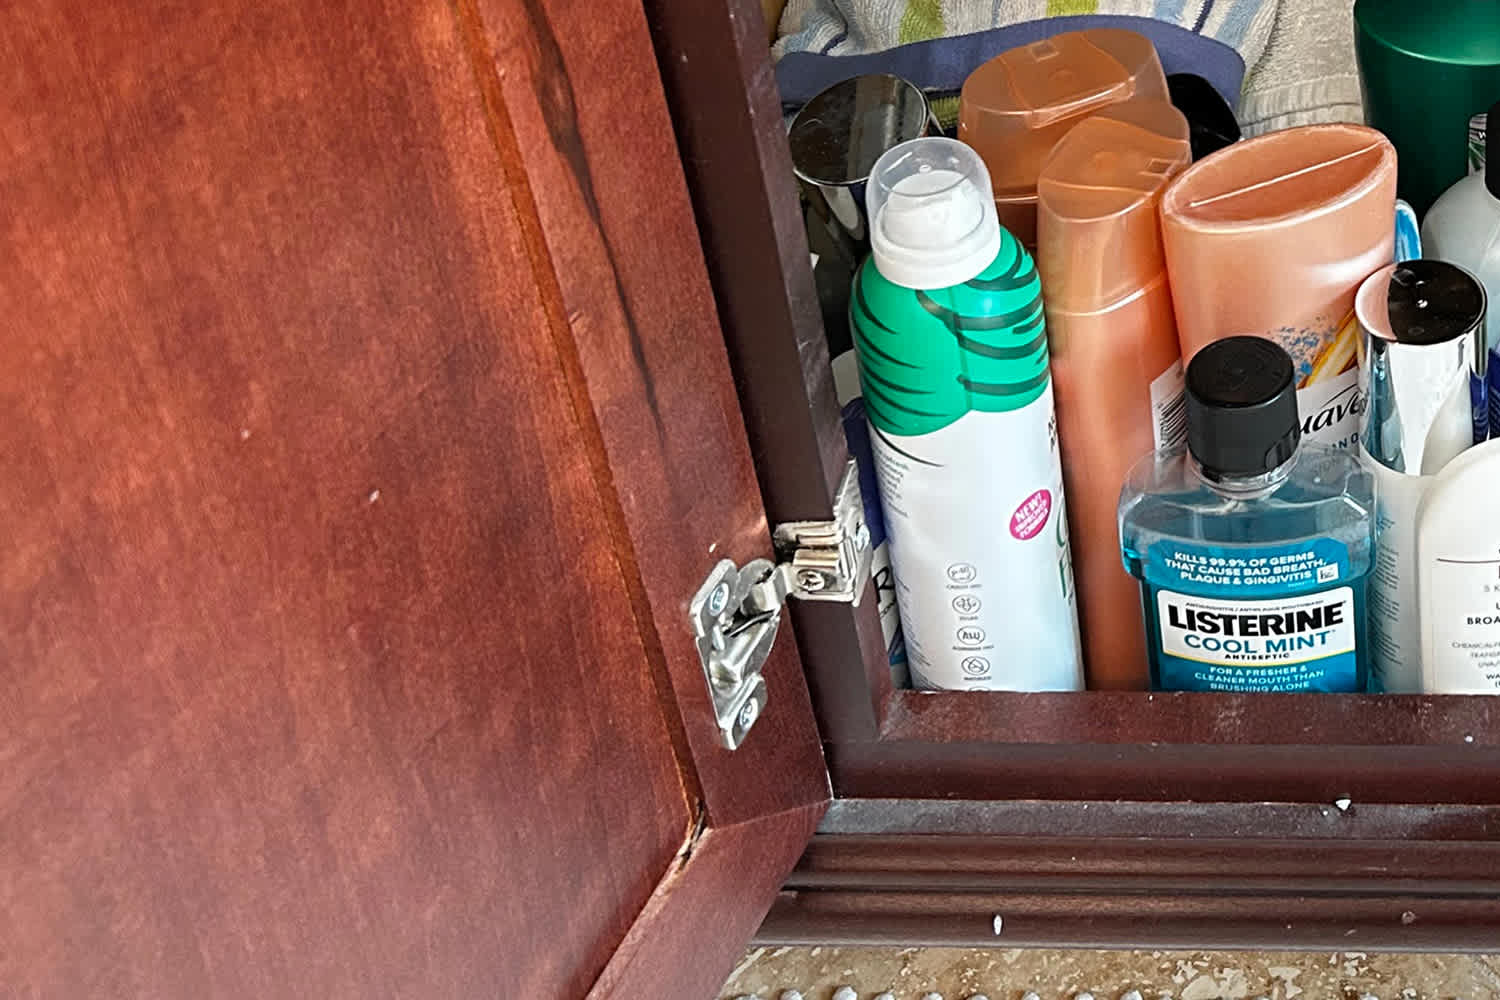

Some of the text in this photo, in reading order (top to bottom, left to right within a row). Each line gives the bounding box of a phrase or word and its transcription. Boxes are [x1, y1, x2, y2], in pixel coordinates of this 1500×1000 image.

[1300, 391, 1361, 434] uave
[1165, 558, 1196, 572] THAT
[1198, 566, 1240, 576] CAUSE
[1244, 568, 1271, 576] BAD
[1273, 559, 1327, 574] BREATH,
[1175, 552, 1315, 567] KILLS 99.9% OF GERMS
[1181, 572, 1230, 584] PLAQUE
[1233, 577, 1241, 585] &
[1244, 570, 1312, 585] GINGIVITIS
[1167, 601, 1345, 637] LISTERINE
[1184, 630, 1331, 653] COOL MINT
[1195, 669, 1324, 684] CLEANER MOUTH THAN
[1210, 666, 1232, 675] FOR
[1246, 666, 1296, 676] FRESHER
[1210, 681, 1310, 692] BRUSHING ALONE
